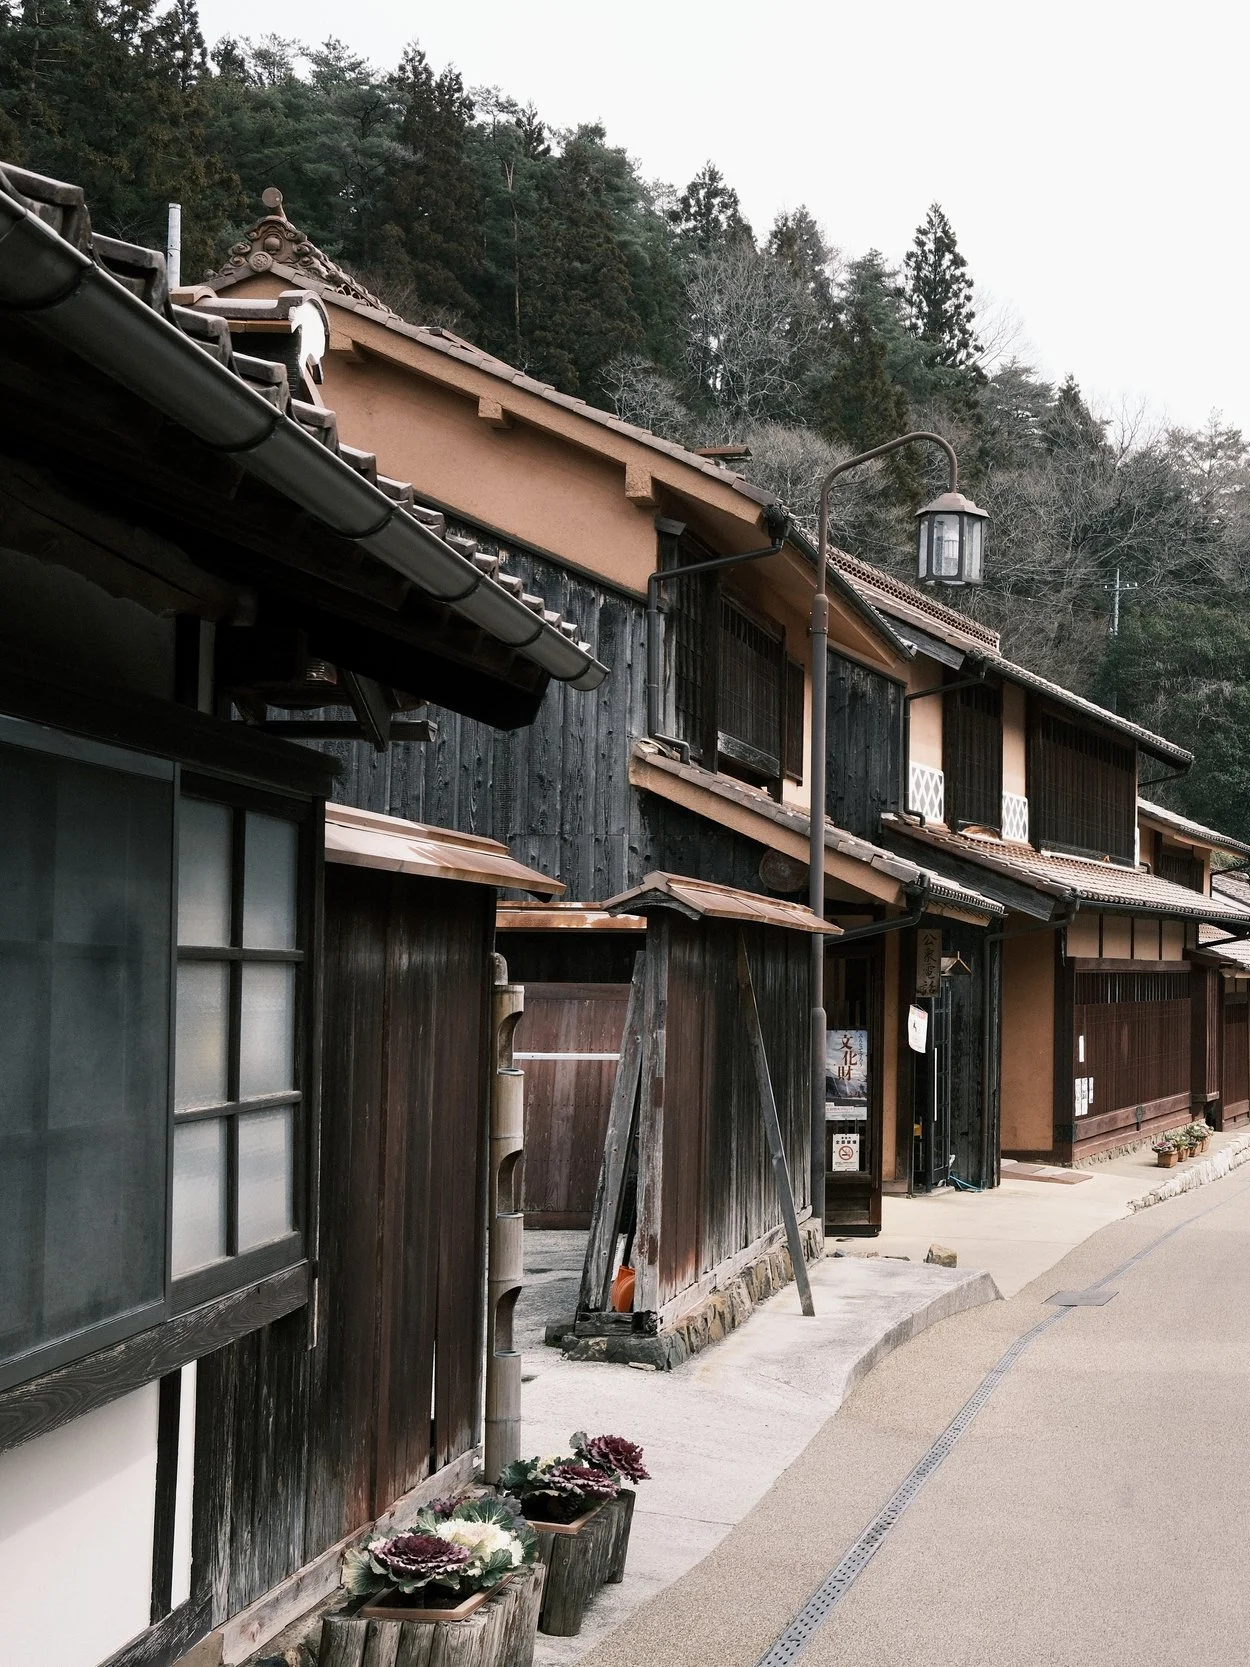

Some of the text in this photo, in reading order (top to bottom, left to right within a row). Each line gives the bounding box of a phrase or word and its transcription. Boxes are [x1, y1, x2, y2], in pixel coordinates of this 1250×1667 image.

[921, 933, 937, 995] 公衆電話
[837, 1034, 858, 1081] 文化財
